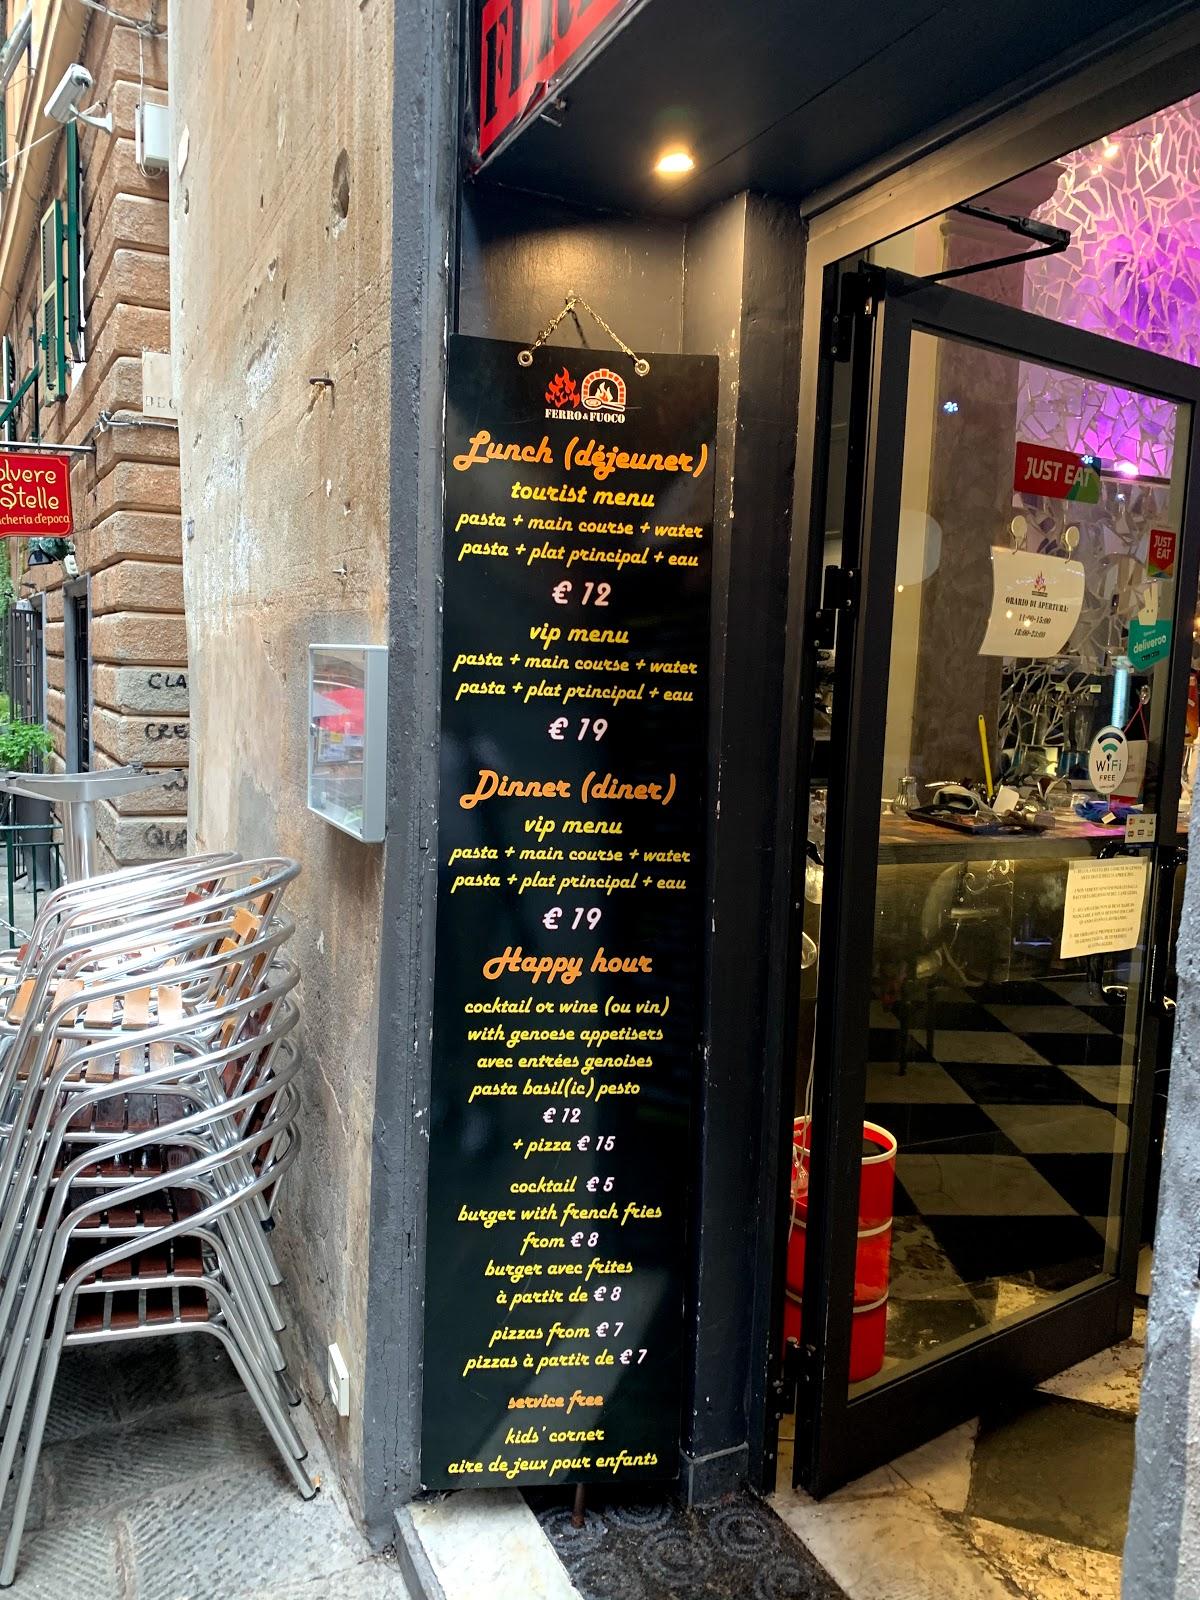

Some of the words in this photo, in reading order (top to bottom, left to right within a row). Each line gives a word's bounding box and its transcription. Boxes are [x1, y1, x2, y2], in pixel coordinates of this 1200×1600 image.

[545, 409, 582, 420] FERRO
[590, 412, 625, 423] FUOCO
[453, 430, 553, 471] Lunch
[565, 436, 708, 480] (déjeuner)
[1024, 456, 1062, 482] JUST
[1064, 464, 1094, 488] EAT
[0, 483, 59, 509] Stelle
[511, 482, 587, 503] tourist
[593, 491, 654, 507] menu
[34, 513, 70, 526] d'epoca
[455, 513, 506, 532] pasta
[513, 514, 523, 525] +
[528, 517, 572, 531] main
[578, 522, 633, 534] course
[640, 522, 650, 533] +
[655, 524, 703, 538] water
[1154, 534, 1172, 548] JUST
[458, 542, 508, 561] pasta
[516, 544, 526, 554] +
[527, 542, 565, 565] plat
[566, 548, 649, 570] principal
[654, 552, 664, 562] +
[668, 555, 698, 566] eau
[1157, 548, 1172, 560] EAT
[552, 581, 572, 604] €
[582, 582, 611, 606] 12
[1006, 596, 1028, 606] ORARIO
[530, 623, 560, 650] vip
[568, 629, 628, 643] menu
[1134, 635, 1166, 654] deliveroo
[453, 653, 503, 672] pasta
[510, 654, 520, 664] +
[525, 656, 569, 669] main
[575, 660, 629, 671] course
[636, 659, 646, 670] +
[650, 661, 697, 674] water
[456, 681, 505, 700] pasta
[512, 682, 523, 693] +
[524, 680, 562, 703] plat
[563, 684, 644, 706] principal
[649, 688, 659, 698] +
[664, 691, 693, 701] eau
[548, 718, 568, 740] €
[578, 718, 608, 741] 19
[1096, 760, 1122, 772] WiFi
[460, 770, 570, 809] Dinner
[582, 771, 676, 805] (diner)
[525, 816, 555, 842] vip
[562, 821, 622, 834] menu
[448, 846, 498, 866] pasta
[505, 846, 515, 857] +
[520, 847, 564, 860] main
[569, 850, 622, 861] course
[630, 849, 639, 859] +
[644, 850, 690, 862] water
[451, 874, 500, 893] pasta
[507, 874, 517, 884] +
[518, 871, 556, 894] plat
[557, 873, 638, 895] principal
[643, 876, 652, 886] +
[657, 880, 686, 889] eau
[543, 907, 562, 929] €
[572, 908, 601, 930] 19
[483, 946, 583, 984] Happy
[590, 947, 652, 972] hour
[465, 997, 532, 1013] cocktail
[536, 1002, 554, 1012] or
[560, 1000, 598, 1013] wine
[605, 996, 630, 1016] (ou
[636, 996, 669, 1016] vin)
[468, 1024, 505, 1040] with
[506, 1029, 574, 1048] genoese
[580, 1028, 663, 1047] appetisers
[477, 1058, 513, 1068] avec
[518, 1054, 579, 1067] entrées
[581, 1054, 652, 1075] genoises
[468, 1082, 517, 1103] pasta
[523, 1077, 594, 1098] basil(ic)
[595, 1082, 640, 1102] pesto
[543, 1108, 556, 1123] €
[562, 1108, 581, 1123] 12
[513, 1139, 523, 1150] +
[524, 1138, 571, 1159] pizza
[577, 1136, 590, 1150] €
[596, 1136, 615, 1150] 15
[510, 1176, 577, 1193] cocktail
[586, 1177, 599, 1192] €
[604, 1177, 614, 1192] 5
[458, 1205, 515, 1228] burger
[521, 1203, 557, 1220] with
[560, 1202, 618, 1227] french
[621, 1202, 662, 1226] fries
[520, 1232, 564, 1256] from
[570, 1232, 584, 1247] €
[588, 1232, 598, 1247] 8
[485, 1260, 542, 1283] burger
[548, 1264, 582, 1274] avec
[585, 1258, 632, 1281] frites
[496, 1290, 507, 1304] à
[509, 1290, 563, 1311] partir
[569, 1286, 588, 1302] de
[594, 1286, 606, 1301] €
[610, 1286, 621, 1301] 8
[489, 1327, 543, 1348] pizzas
[546, 1322, 590, 1346] from
[596, 1322, 609, 1337] €
[614, 1322, 624, 1336] 7
[463, 1356, 517, 1376] pizzas
[523, 1354, 534, 1367] à
[536, 1352, 589, 1374] partir
[595, 1349, 614, 1365] de
[620, 1349, 632, 1364] €
[638, 1349, 647, 1364] 7
[508, 1394, 564, 1408] service
[566, 1390, 603, 1414] free
[549, 1430, 604, 1442] corner
[448, 1460, 483, 1473] aire
[488, 1455, 508, 1472] de
[506, 1458, 548, 1479] jeux
[549, 1457, 590, 1477] pour
[596, 1450, 657, 1474] enfants
